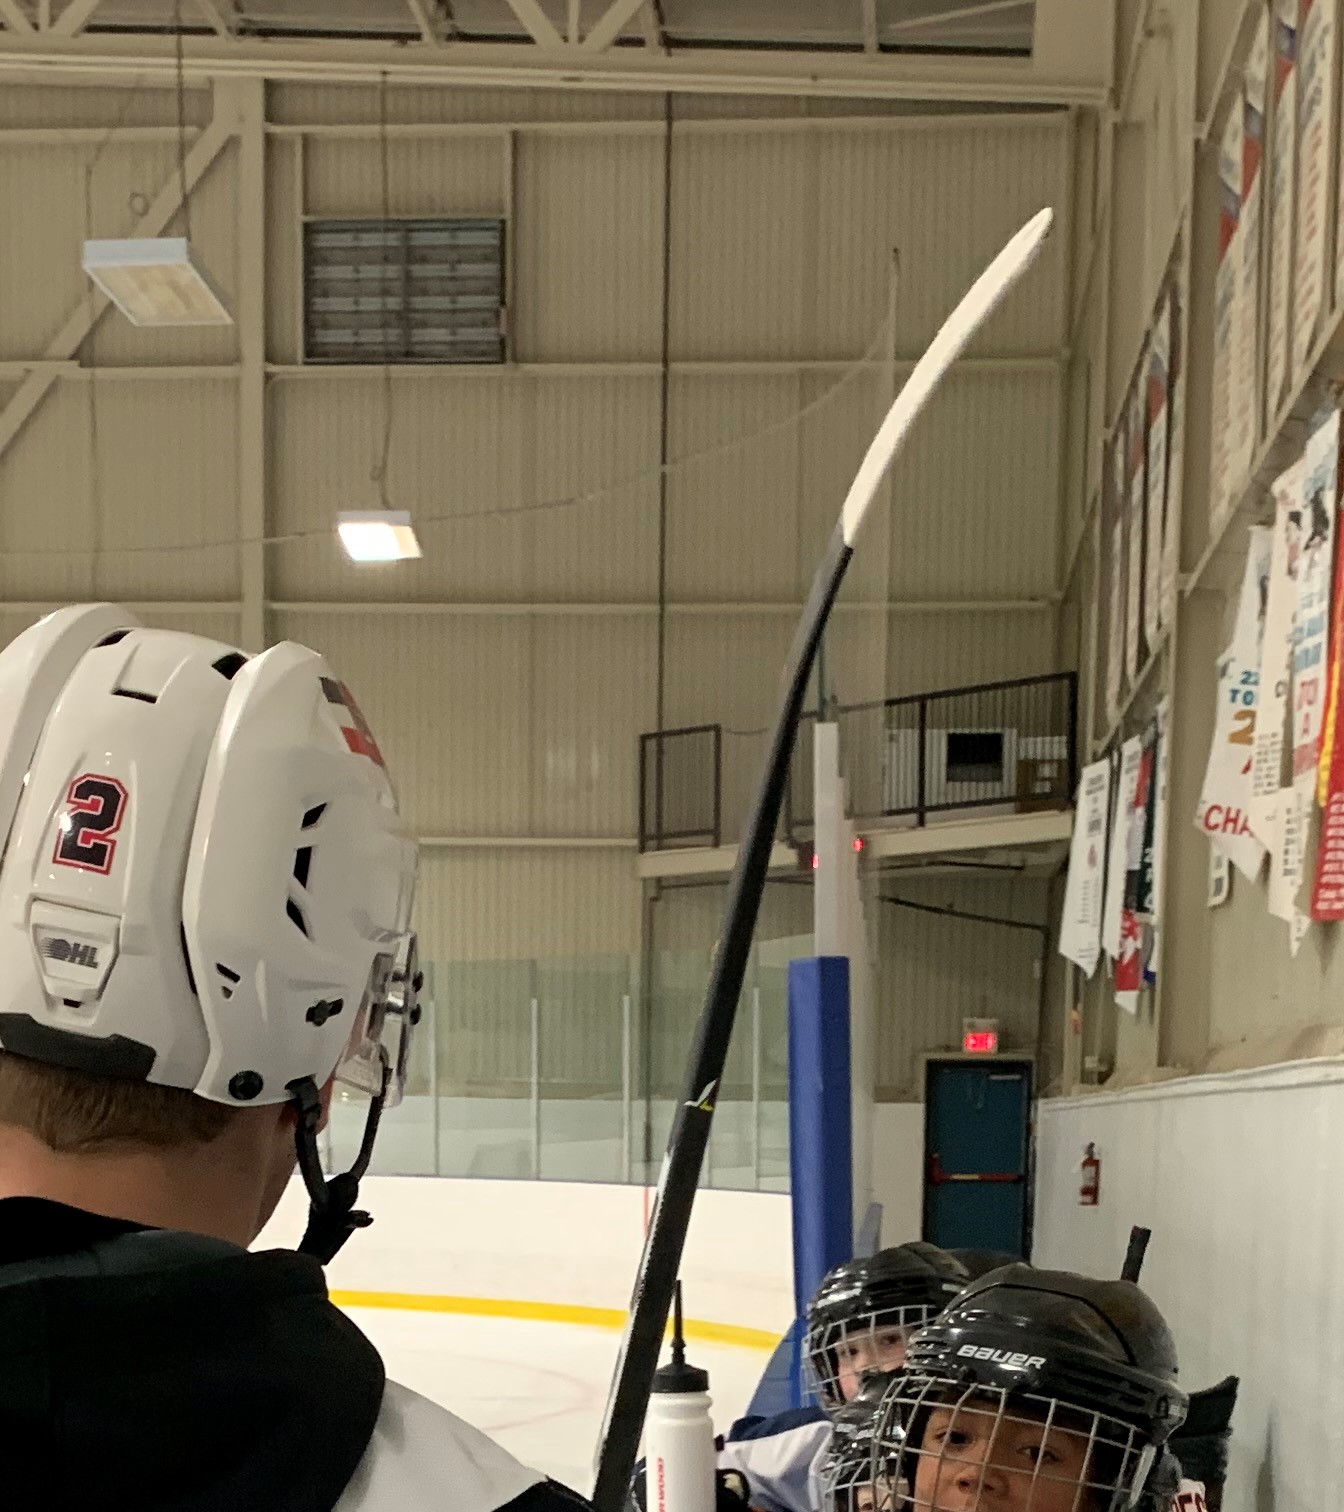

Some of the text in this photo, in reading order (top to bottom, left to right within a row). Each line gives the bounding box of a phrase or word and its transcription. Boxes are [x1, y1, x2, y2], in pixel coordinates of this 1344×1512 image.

[52, 772, 129, 876] 2
[40, 936, 99, 969] OHL
[956, 1344, 1047, 1370] BAUER
